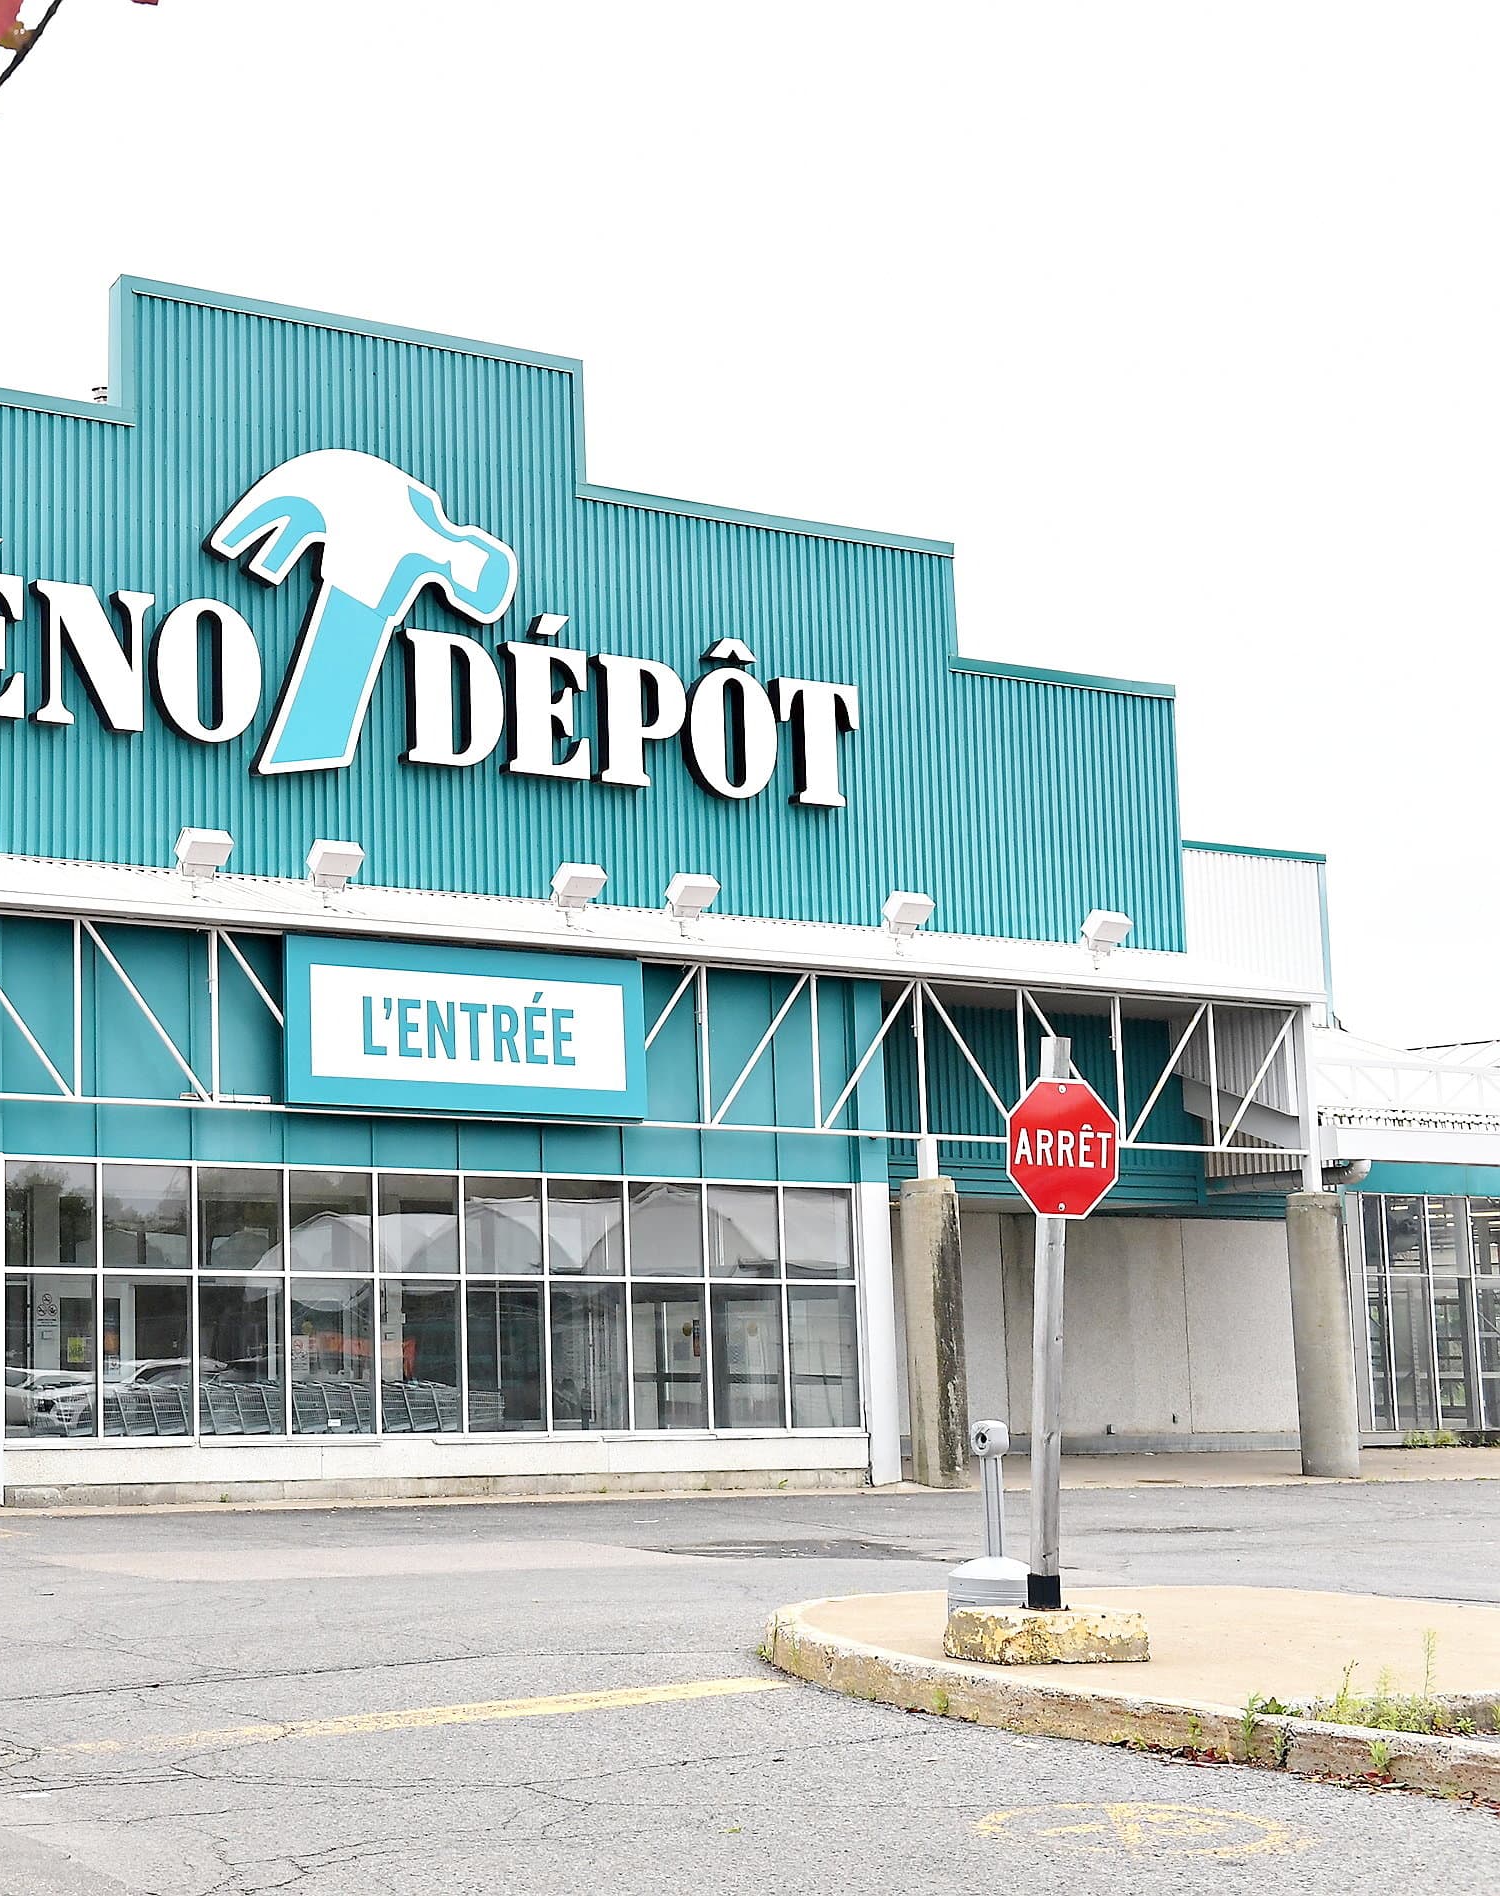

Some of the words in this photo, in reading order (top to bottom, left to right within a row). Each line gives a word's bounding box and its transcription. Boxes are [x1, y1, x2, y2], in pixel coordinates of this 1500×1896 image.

[400, 613, 859, 809] DÉPÔT
[362, 991, 576, 1066] L'ENTRÉE
[1014, 1123, 1113, 1169] ARRÊT
